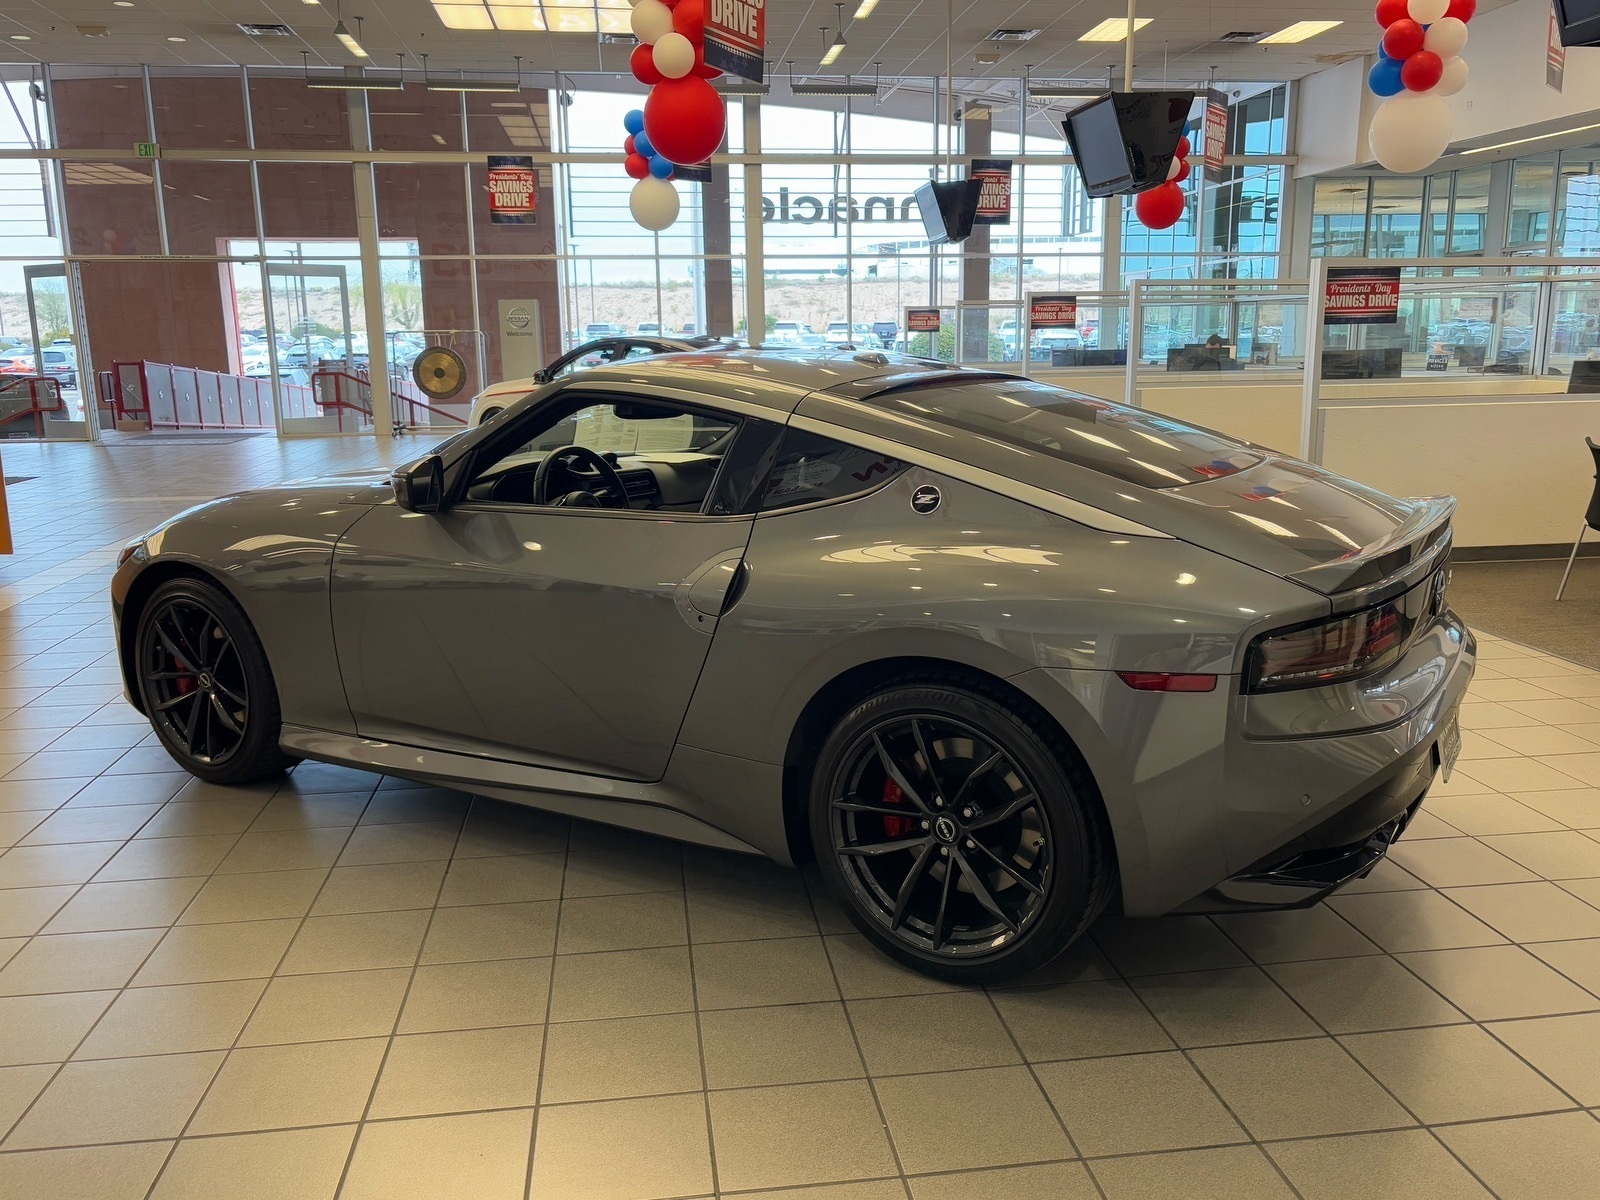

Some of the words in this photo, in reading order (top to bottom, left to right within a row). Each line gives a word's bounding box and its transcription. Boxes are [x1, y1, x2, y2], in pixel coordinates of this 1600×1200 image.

[711, 0, 758, 39] DRIVE
[1206, 121, 1227, 143] SAVINGS
[138, 143, 155, 157] EXIT
[1206, 139, 1222, 160] DRIVE
[519, 173, 533, 182] Day
[489, 180, 534, 193] SAVINGS
[980, 183, 1011, 195] AVINGS
[494, 192, 530, 207] DRIVE
[1330, 283, 1374, 294] Presidents'
[1374, 283, 1393, 295] Day
[1324, 294, 1367, 308] SAVINGS
[1367, 293, 1399, 307] DRIVE
[1034, 304, 1060, 312] Presidents'
[1061, 304, 1073, 312] Day
[1030, 312, 1057, 320] SAVINGS
[1057, 311, 1076, 320] DRIVE
